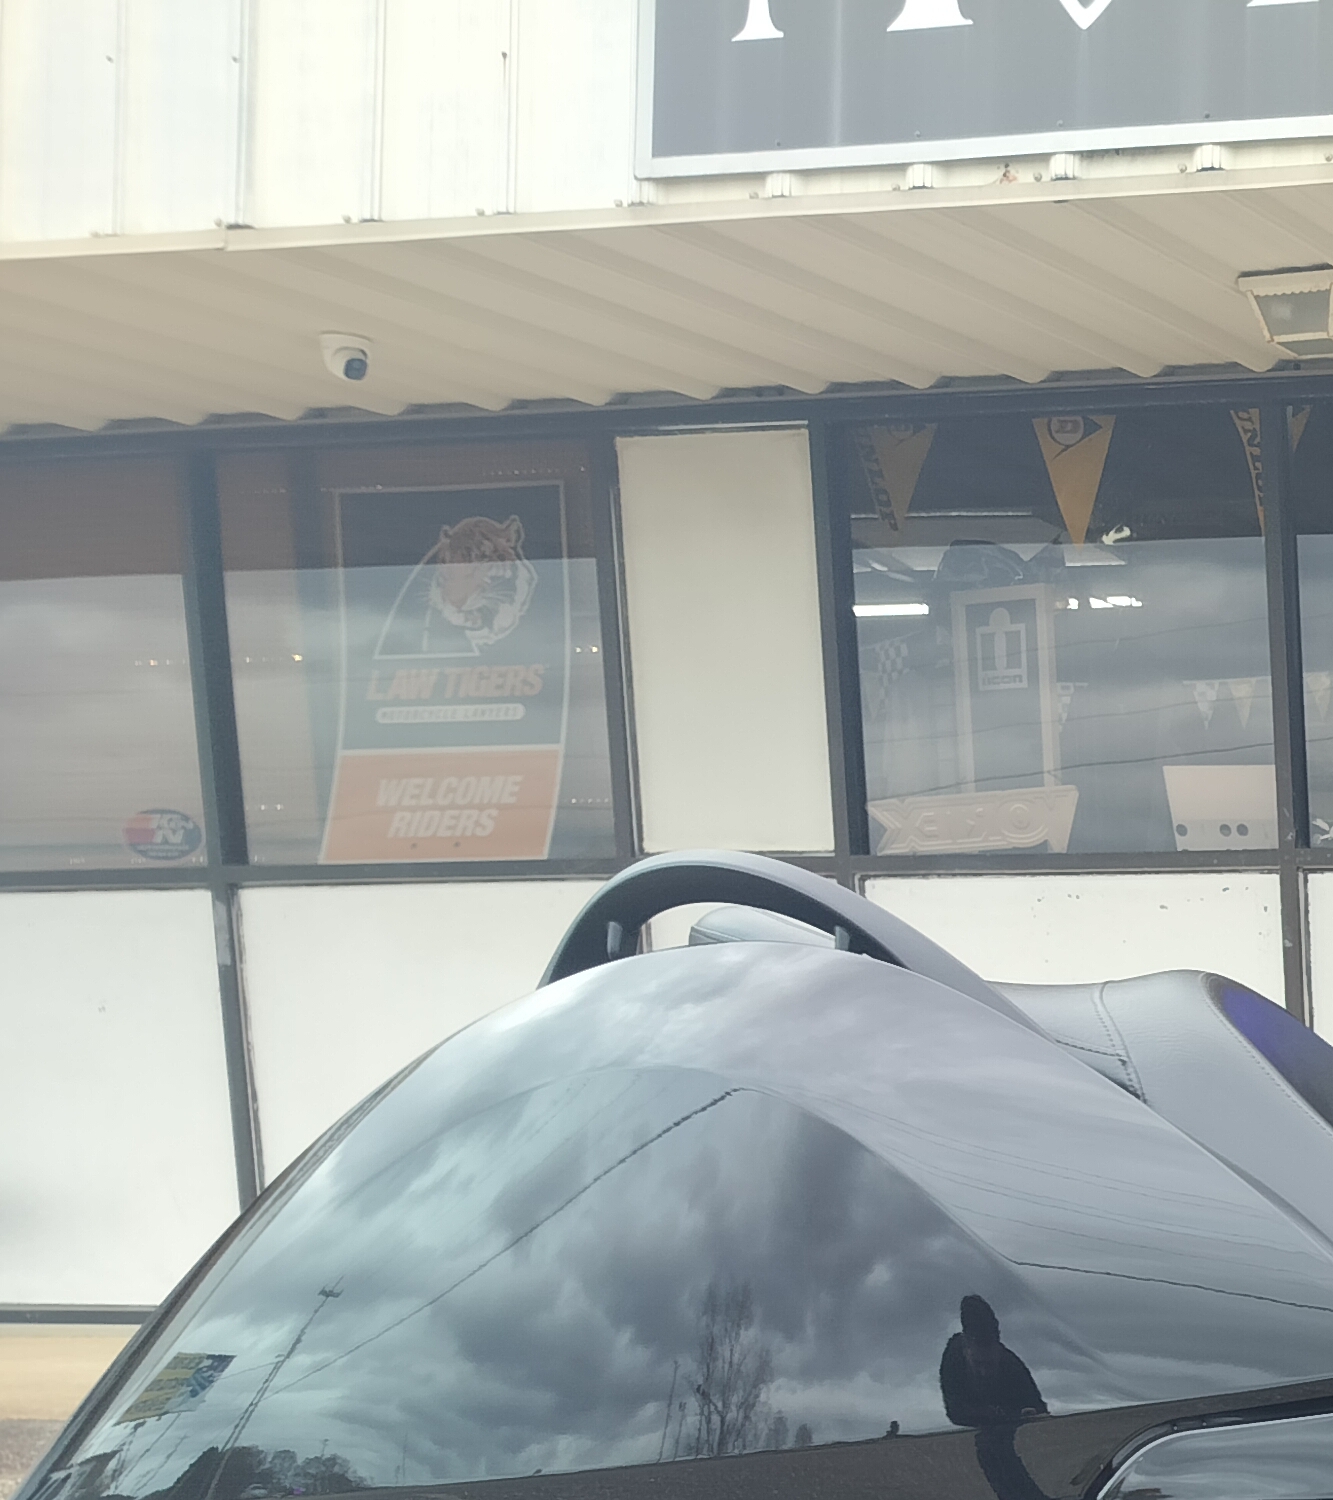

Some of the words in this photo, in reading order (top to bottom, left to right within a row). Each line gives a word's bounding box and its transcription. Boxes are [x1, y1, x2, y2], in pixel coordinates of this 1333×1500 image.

[366, 668, 439, 700] LAW
[444, 664, 545, 698] TIGERS
[376, 774, 524, 807] WELCOME
[388, 808, 499, 838] RIDERS
